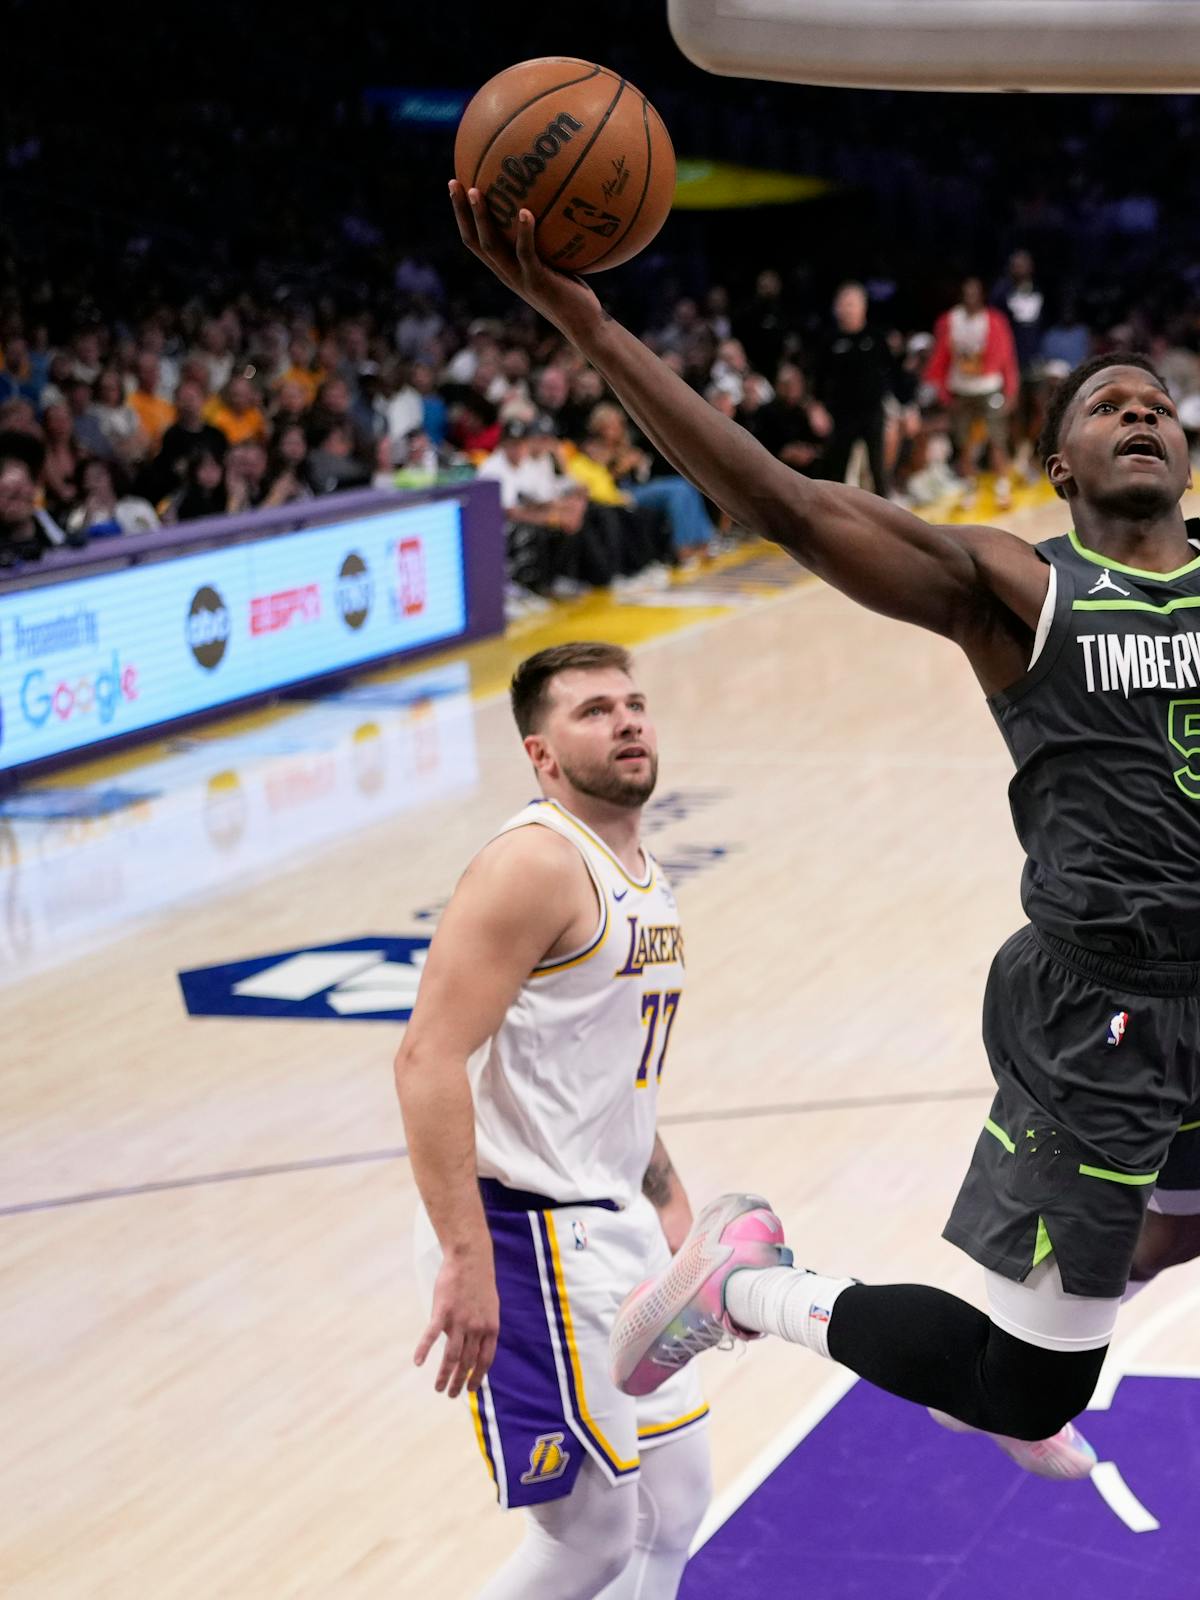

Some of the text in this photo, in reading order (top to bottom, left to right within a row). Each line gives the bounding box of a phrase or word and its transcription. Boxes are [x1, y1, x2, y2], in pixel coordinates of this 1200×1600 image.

[250, 584, 322, 636] ESPN
[20, 652, 138, 726] Google
[635, 989, 682, 1088] 77
